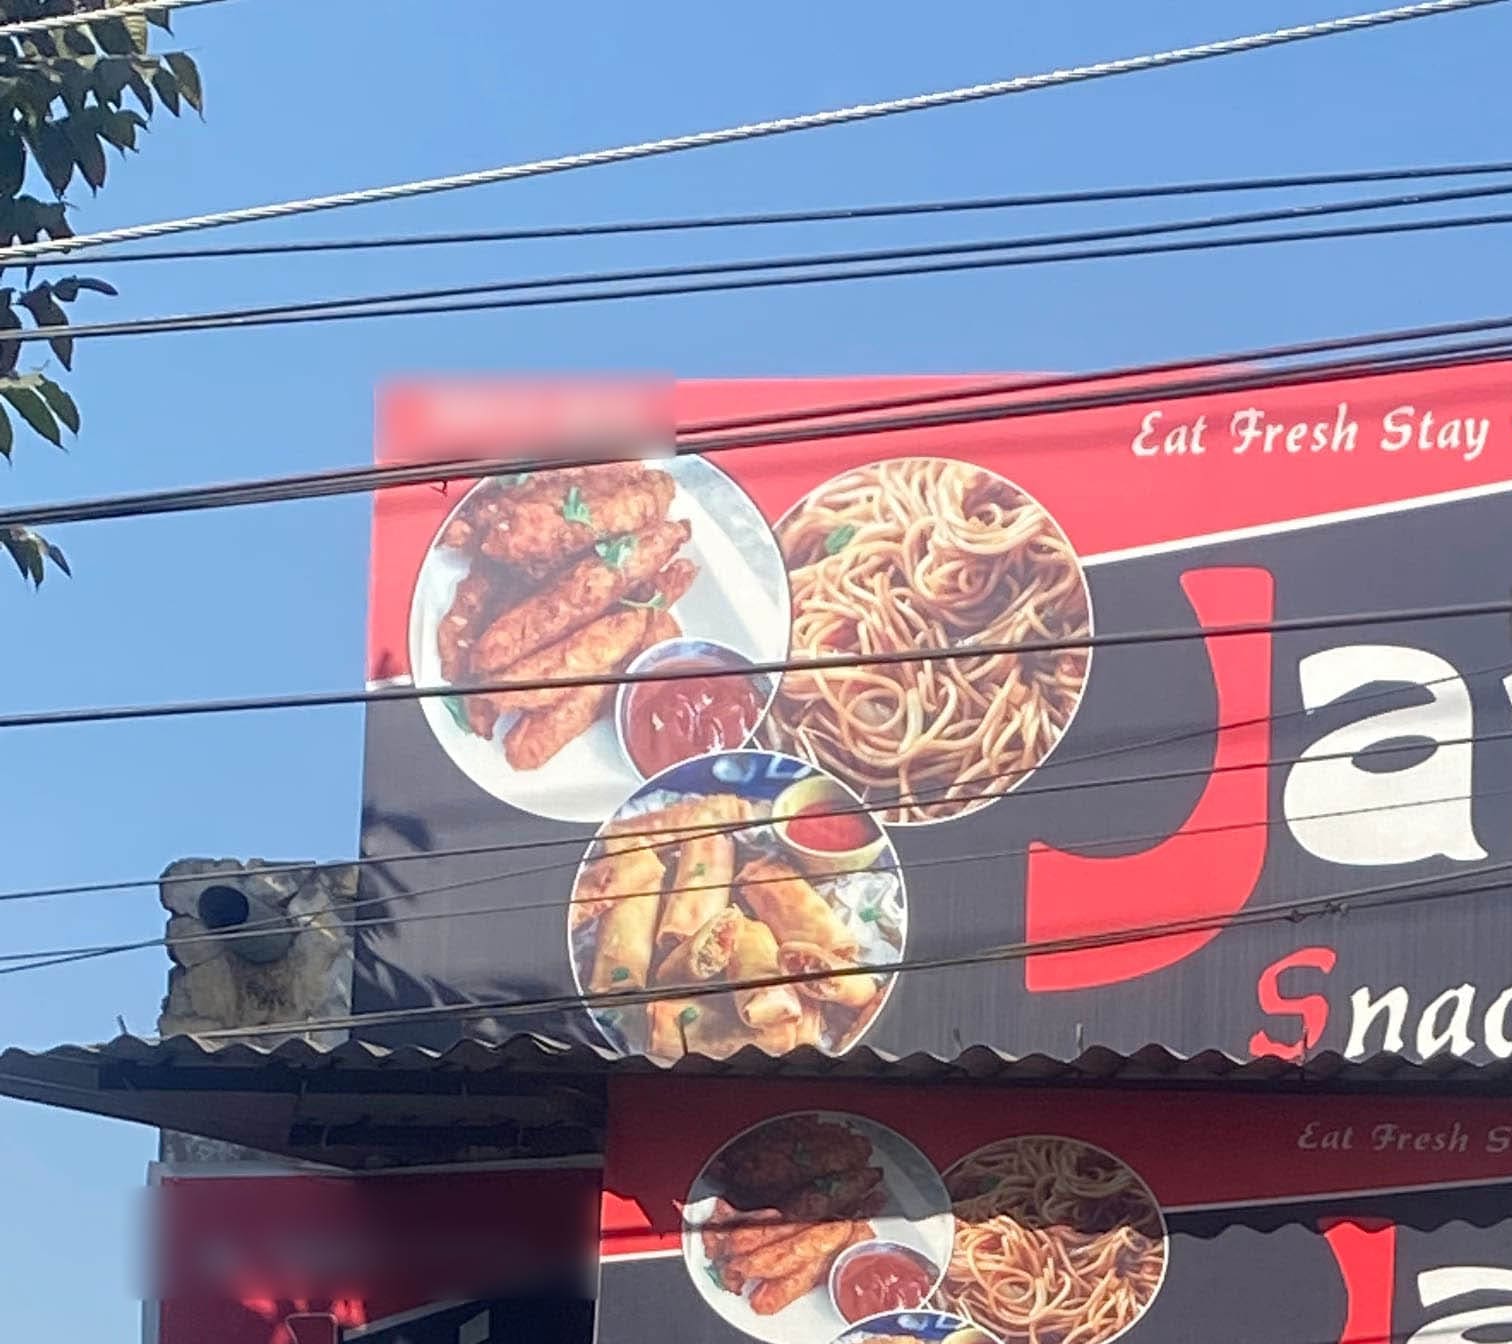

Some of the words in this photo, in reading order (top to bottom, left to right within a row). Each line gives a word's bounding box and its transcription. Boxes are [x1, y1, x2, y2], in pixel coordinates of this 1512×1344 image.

[1131, 410, 1206, 456] Eat
[1231, 402, 1358, 454] Fresh
[1380, 407, 1490, 460] Stay
[1297, 1122, 1352, 1152] Eat
[1370, 1121, 1469, 1153] Fresh
